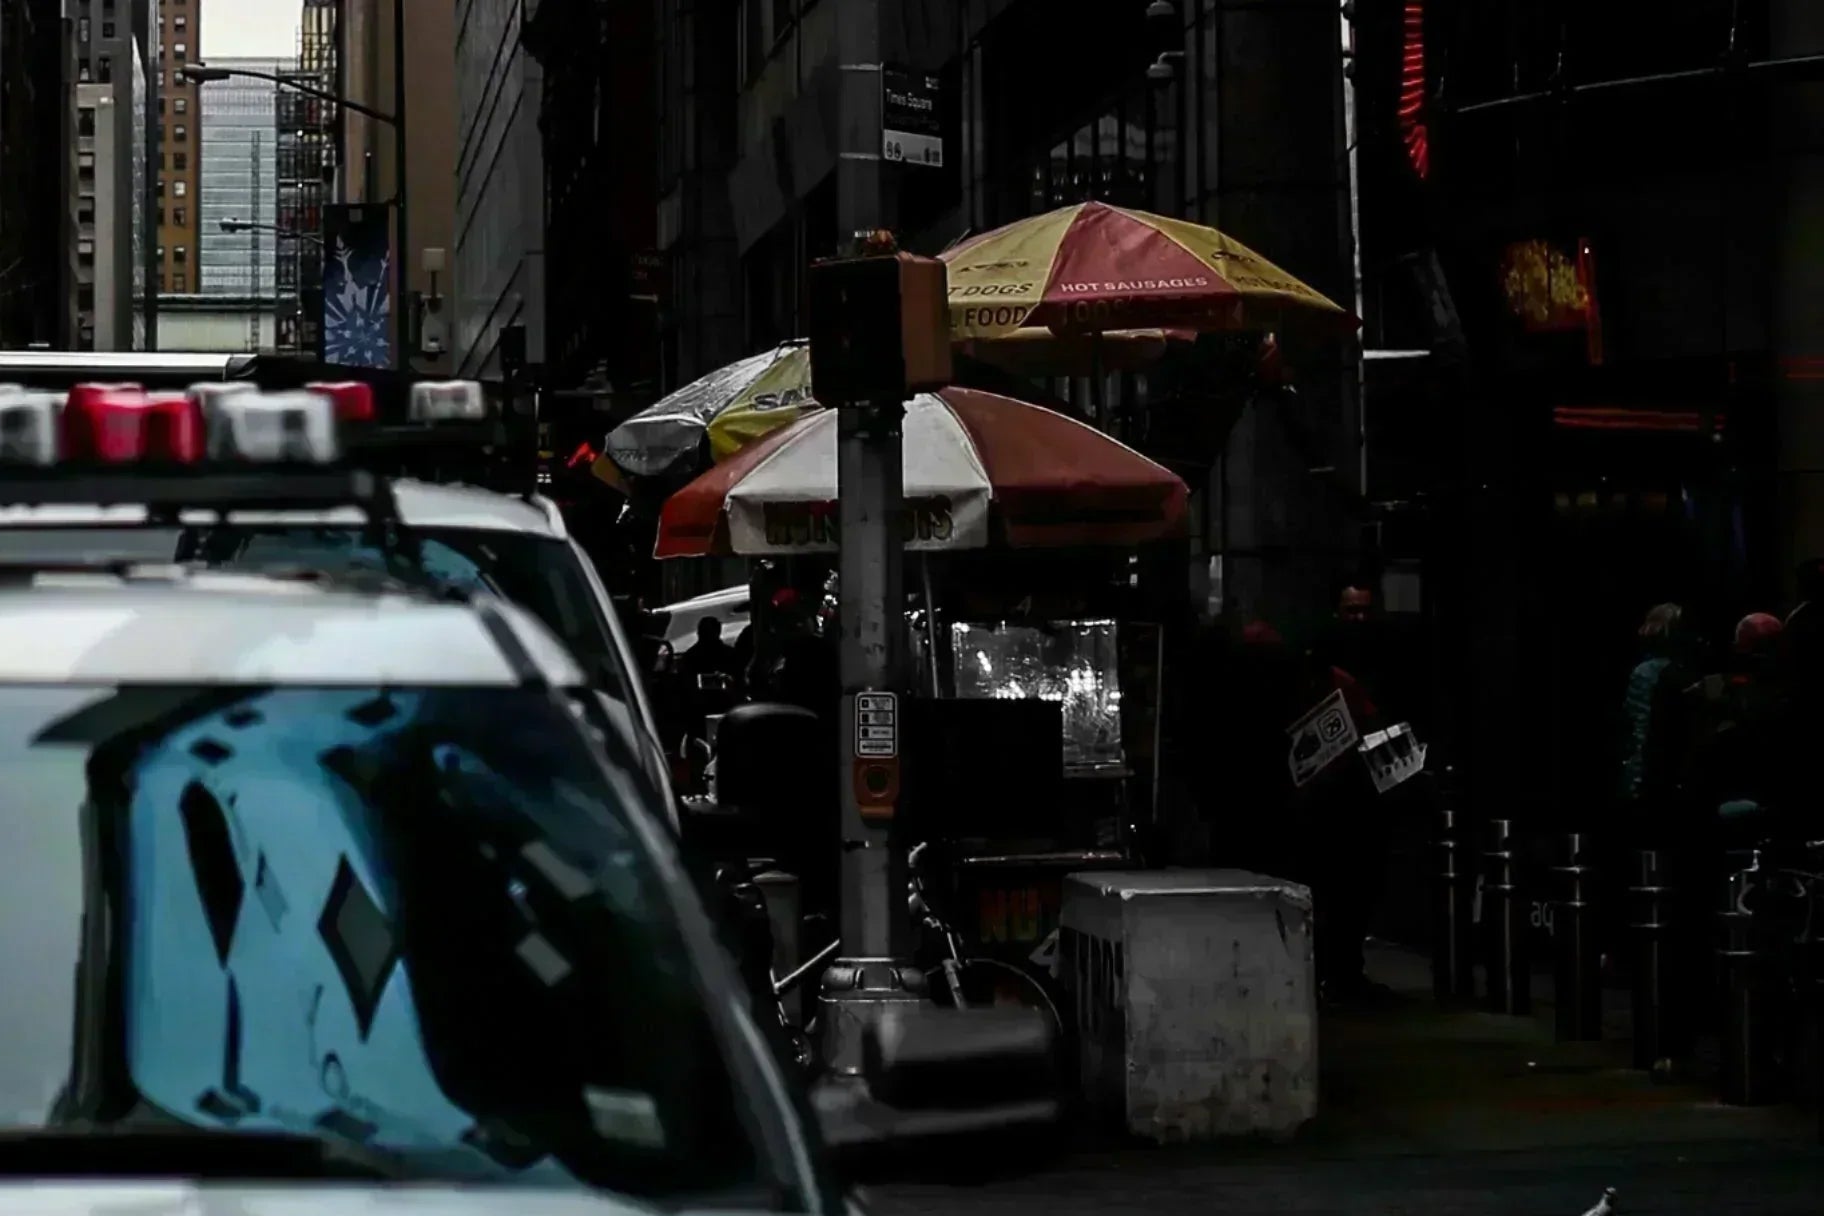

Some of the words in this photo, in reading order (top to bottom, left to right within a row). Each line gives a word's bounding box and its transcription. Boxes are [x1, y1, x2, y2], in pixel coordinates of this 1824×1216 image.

[962, 282, 1034, 297] DOGS
[1060, 281, 1102, 294] HOT
[1103, 276, 1209, 291] SAUSAGES
[964, 305, 1028, 328] FOOD
